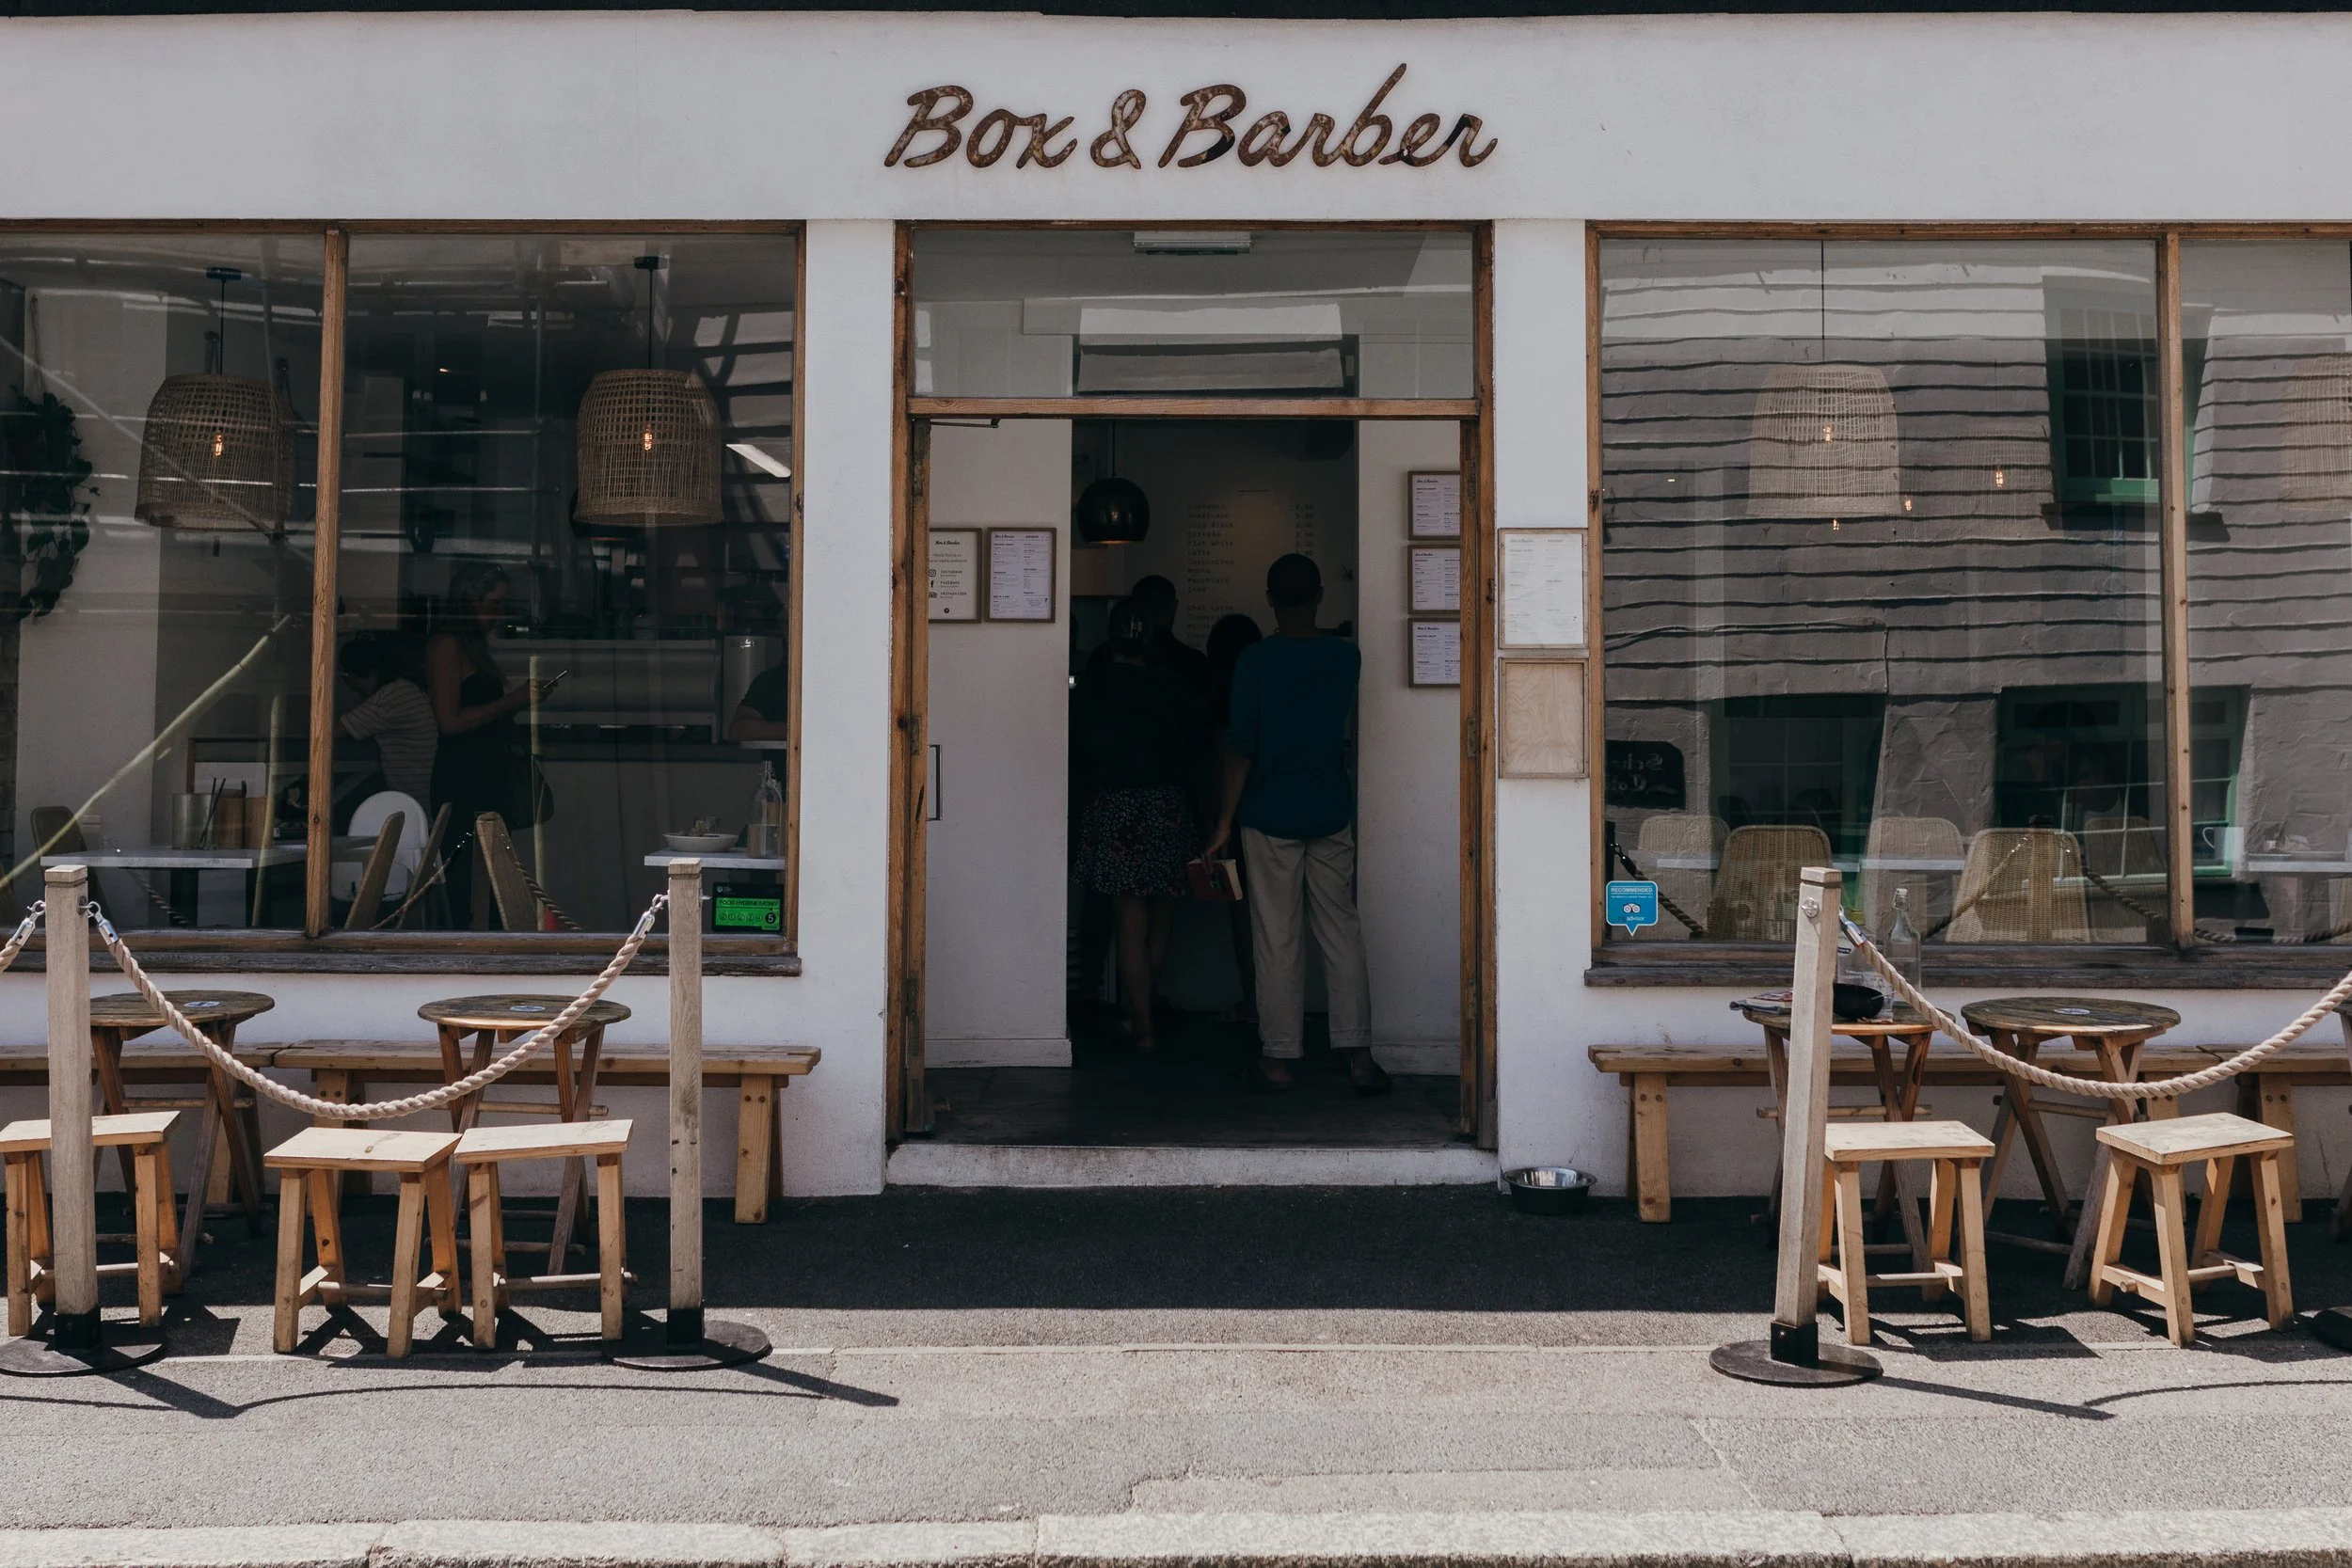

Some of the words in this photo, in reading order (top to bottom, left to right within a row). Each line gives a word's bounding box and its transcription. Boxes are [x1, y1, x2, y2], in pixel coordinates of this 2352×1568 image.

[884, 85, 1077, 169] Box
[1090, 89, 1147, 169] &
[1158, 63, 1498, 169] Barber
[768, 913, 773, 923] 5
